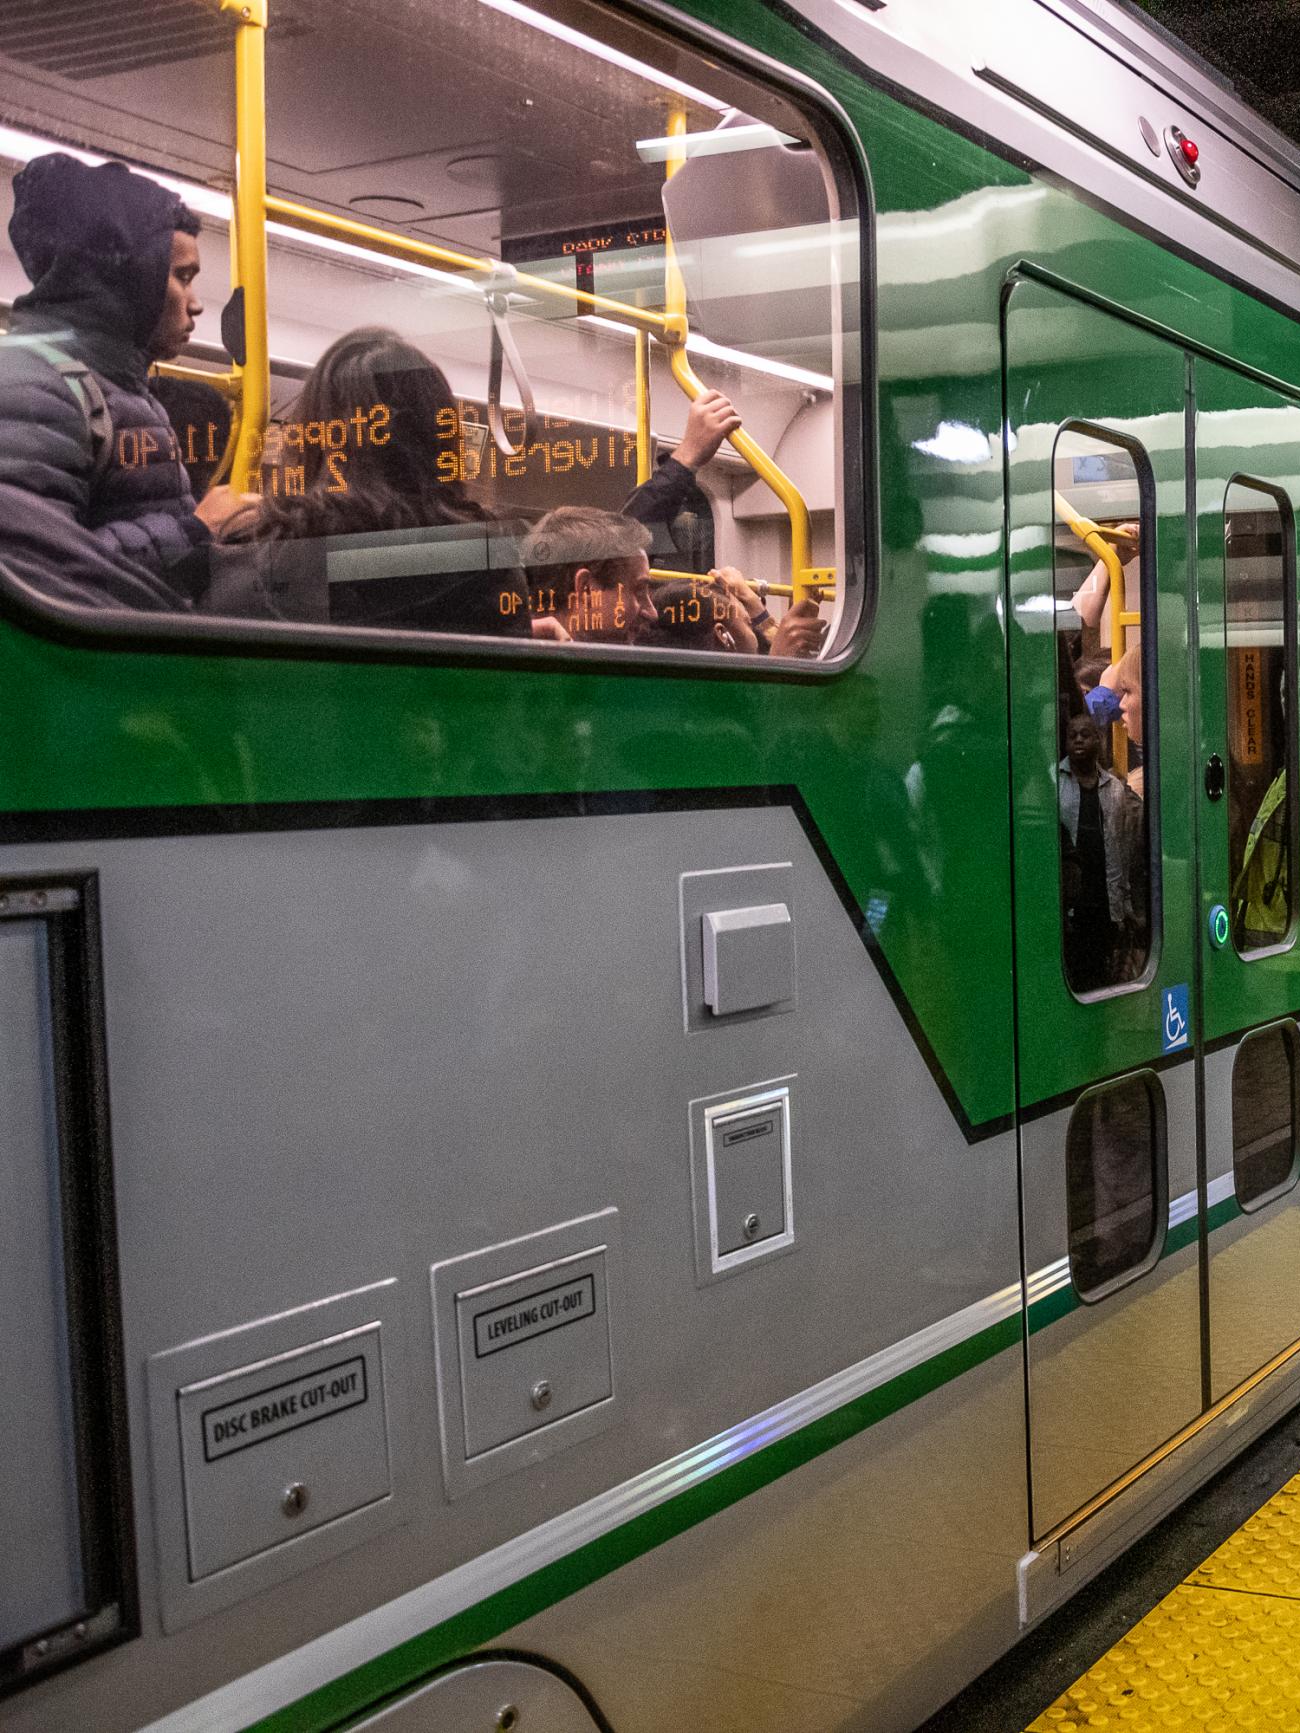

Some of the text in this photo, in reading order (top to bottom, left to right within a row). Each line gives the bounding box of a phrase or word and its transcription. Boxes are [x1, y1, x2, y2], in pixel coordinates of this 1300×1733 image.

[1245, 653, 1255, 700] HANDS
[1246, 709, 1257, 755] CLEAR
[487, 1291, 583, 1340] LEVELING CUT-OUT
[213, 1372, 358, 1443] DISC BRAKE CUT-OUT
